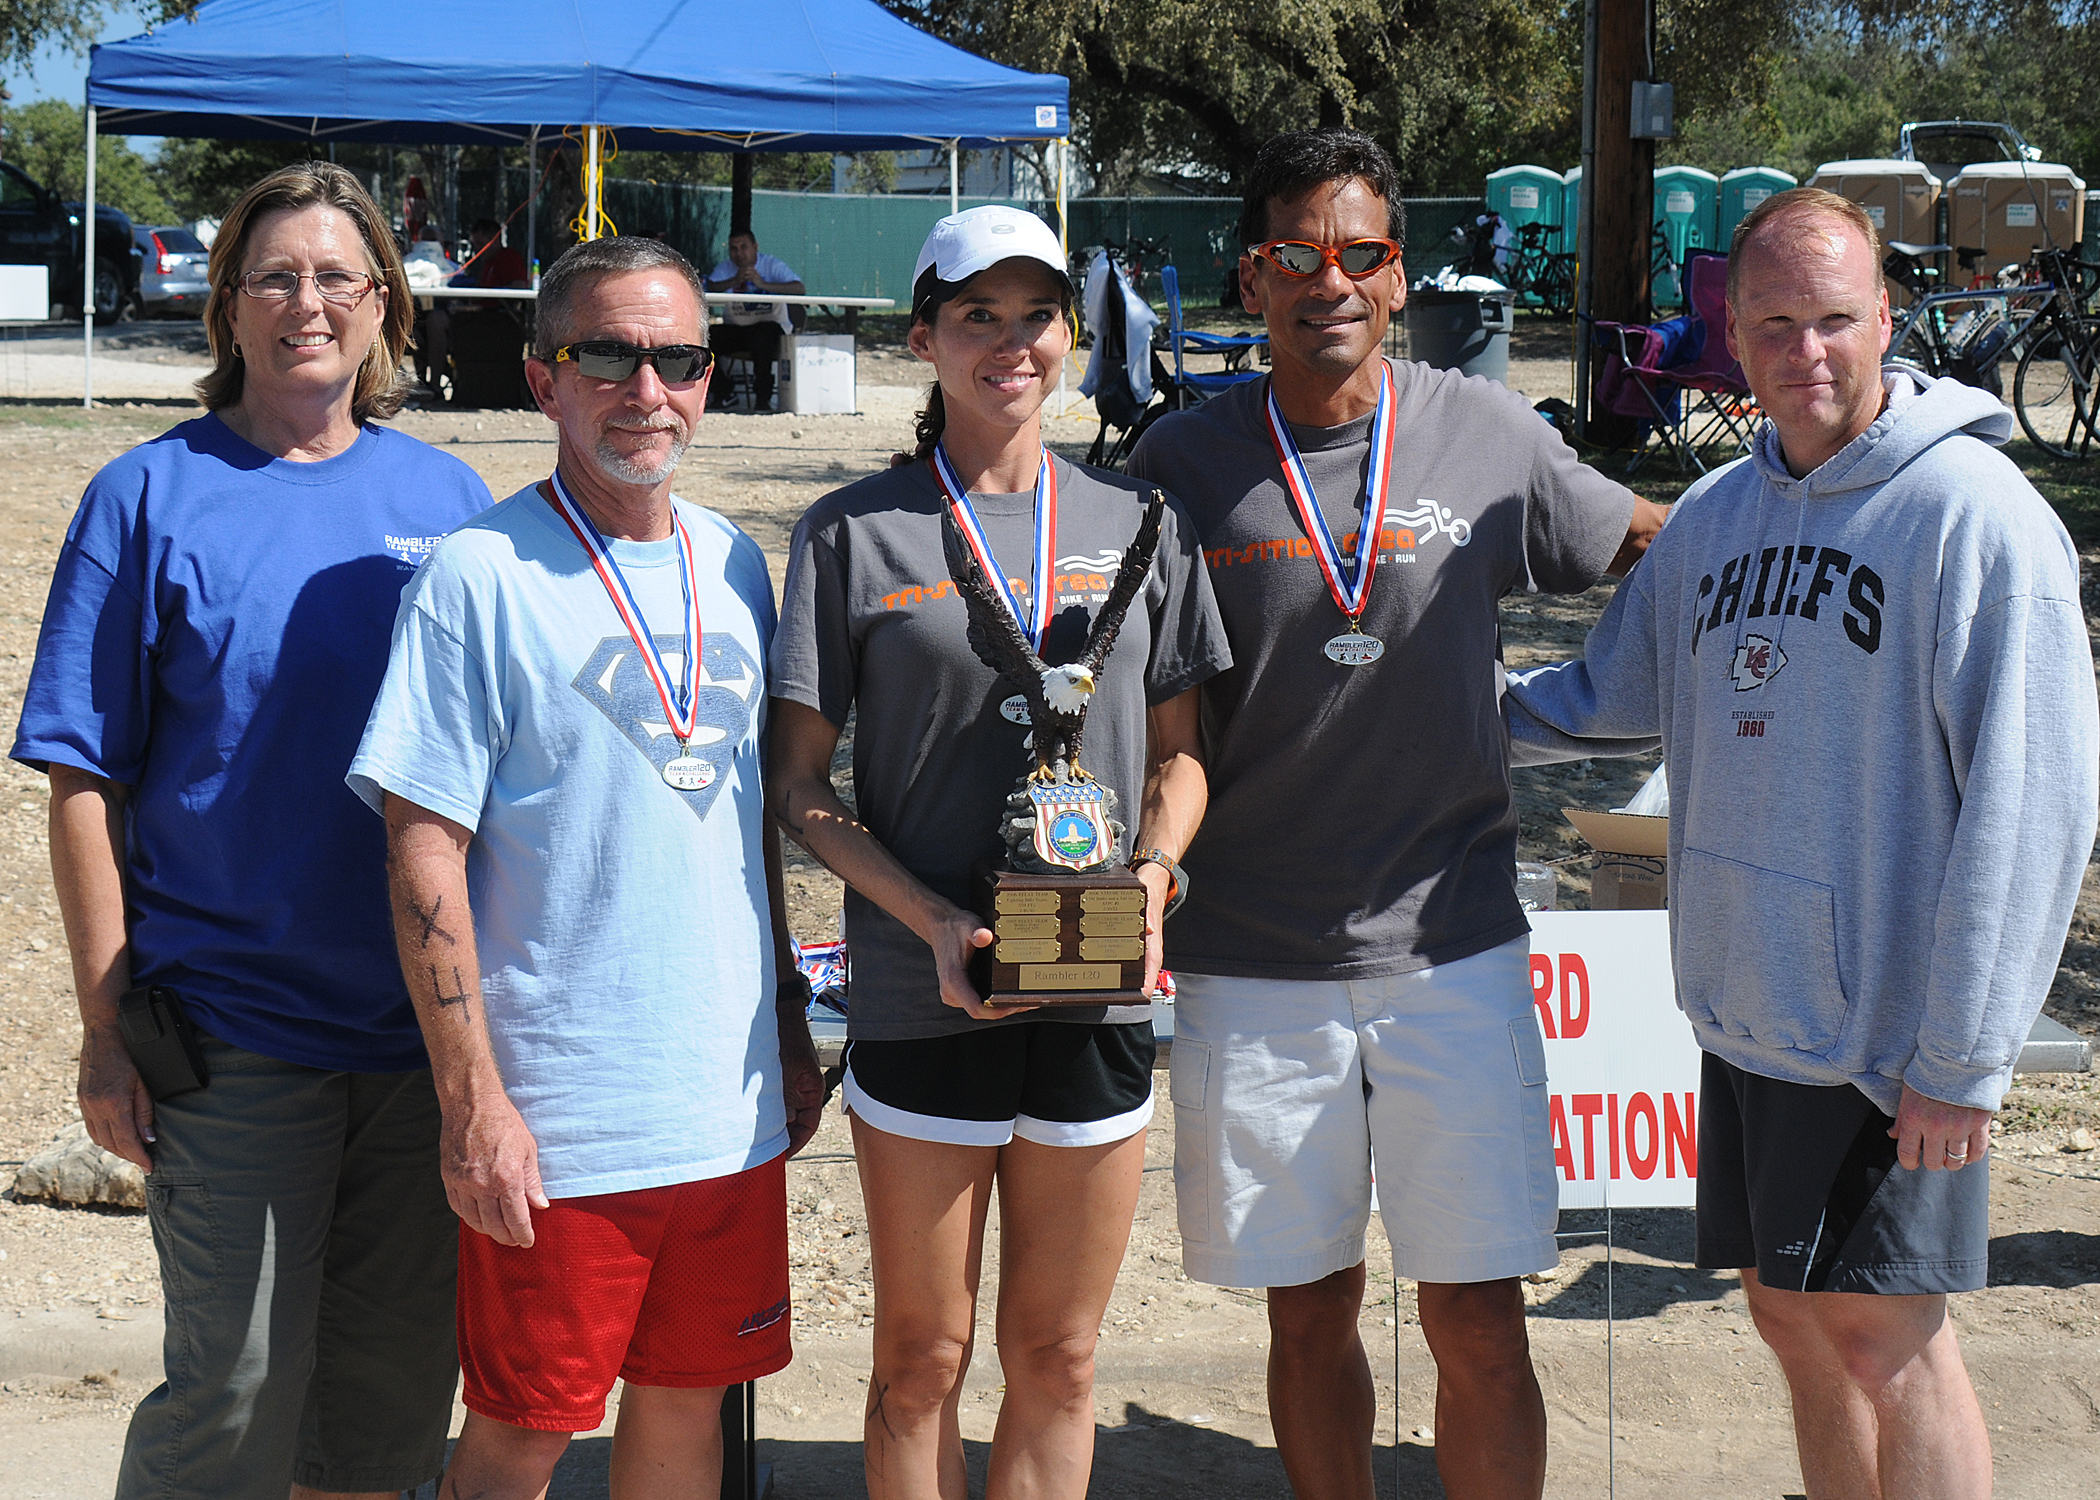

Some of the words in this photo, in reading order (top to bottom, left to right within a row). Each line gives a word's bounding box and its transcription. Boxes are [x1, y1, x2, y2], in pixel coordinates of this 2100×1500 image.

[386, 543, 409, 552] TEAM
[1343, 528, 1416, 553] aea
[1395, 553, 1416, 563] RUN
[1055, 573, 1108, 592] rea
[1059, 594, 1083, 605] BIKE
[1691, 545, 1885, 656] CHIEFS
[1731, 711, 1775, 720] ESTABLISHED
[1736, 720, 1766, 737] 1960
[408, 895, 456, 949] X
[1034, 970, 1078, 980] Rambler
[1082, 970, 1100, 980] 120
[430, 964, 472, 1024] 4
